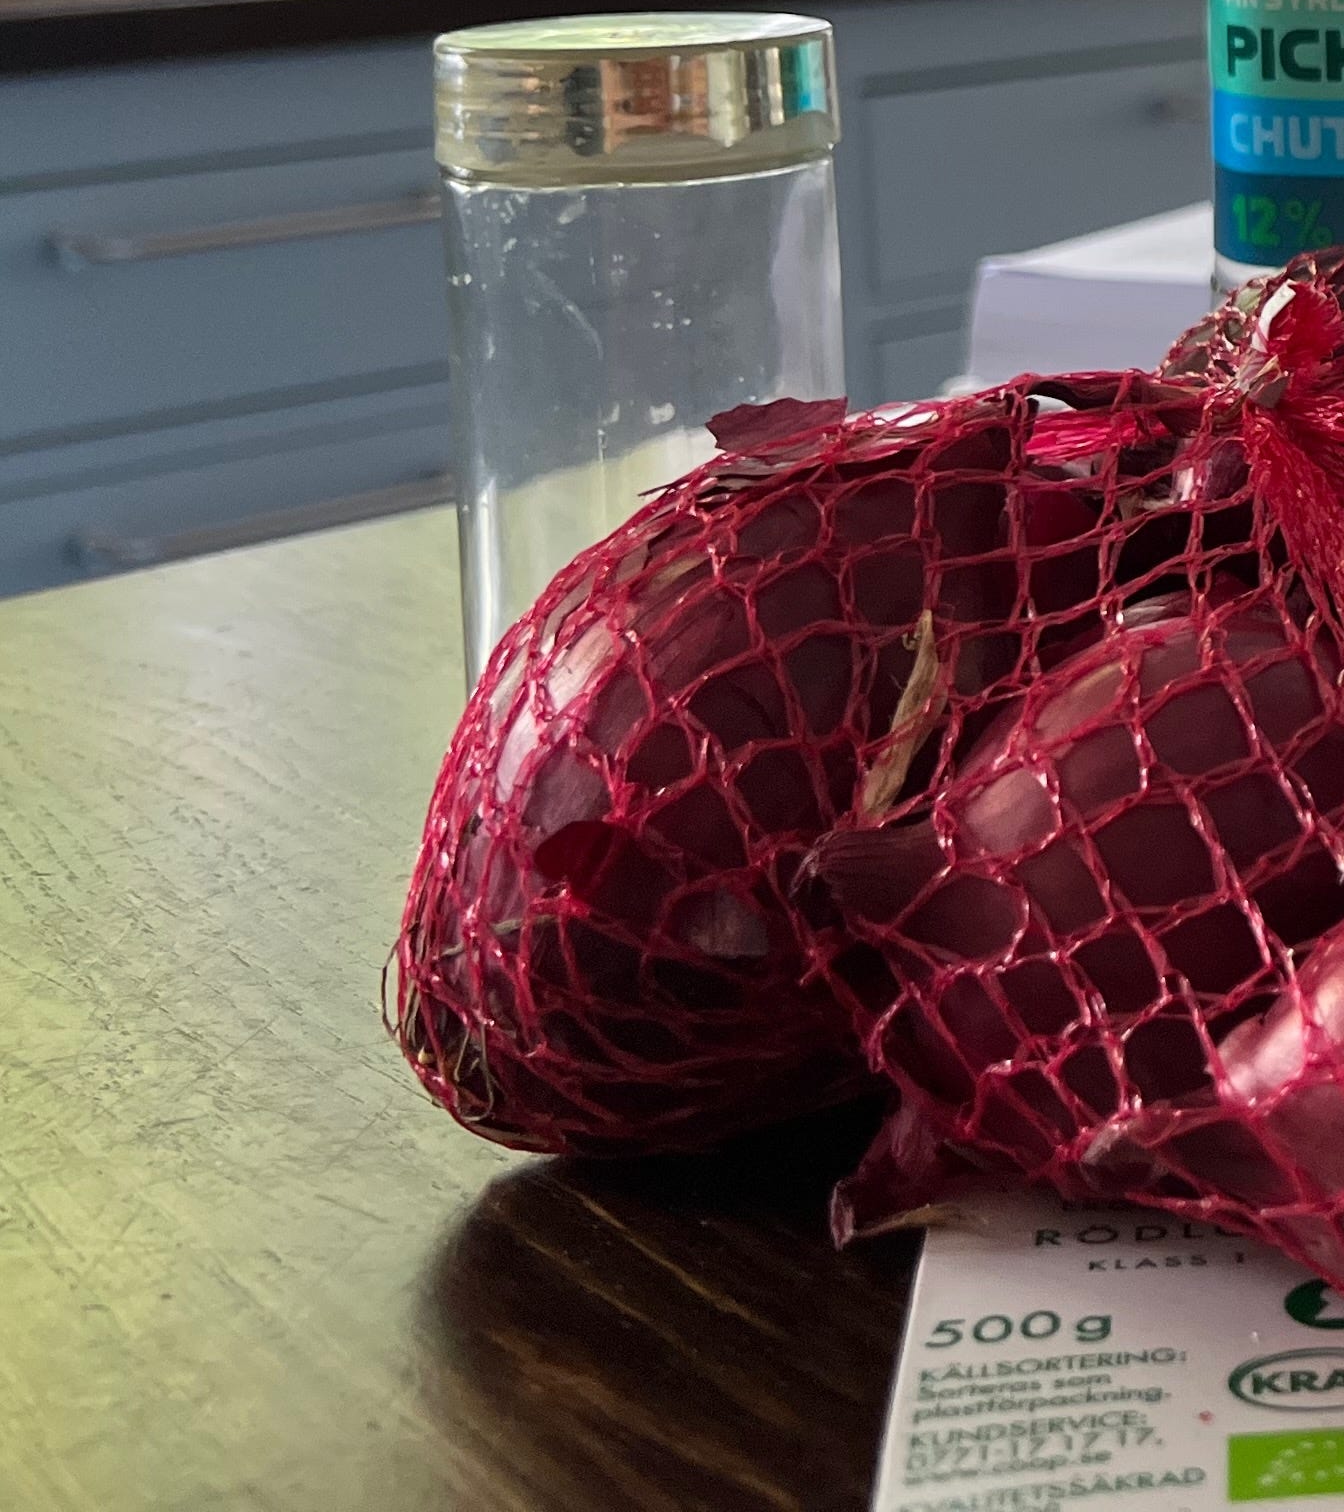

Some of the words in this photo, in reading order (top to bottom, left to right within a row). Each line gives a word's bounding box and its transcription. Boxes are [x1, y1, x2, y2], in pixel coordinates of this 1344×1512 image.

[1088, 1254, 1209, 1271] KLASS
[925, 1309, 1062, 1349] 500
[1075, 1310, 1114, 1344] g
[1053, 1373, 1112, 1390] som
